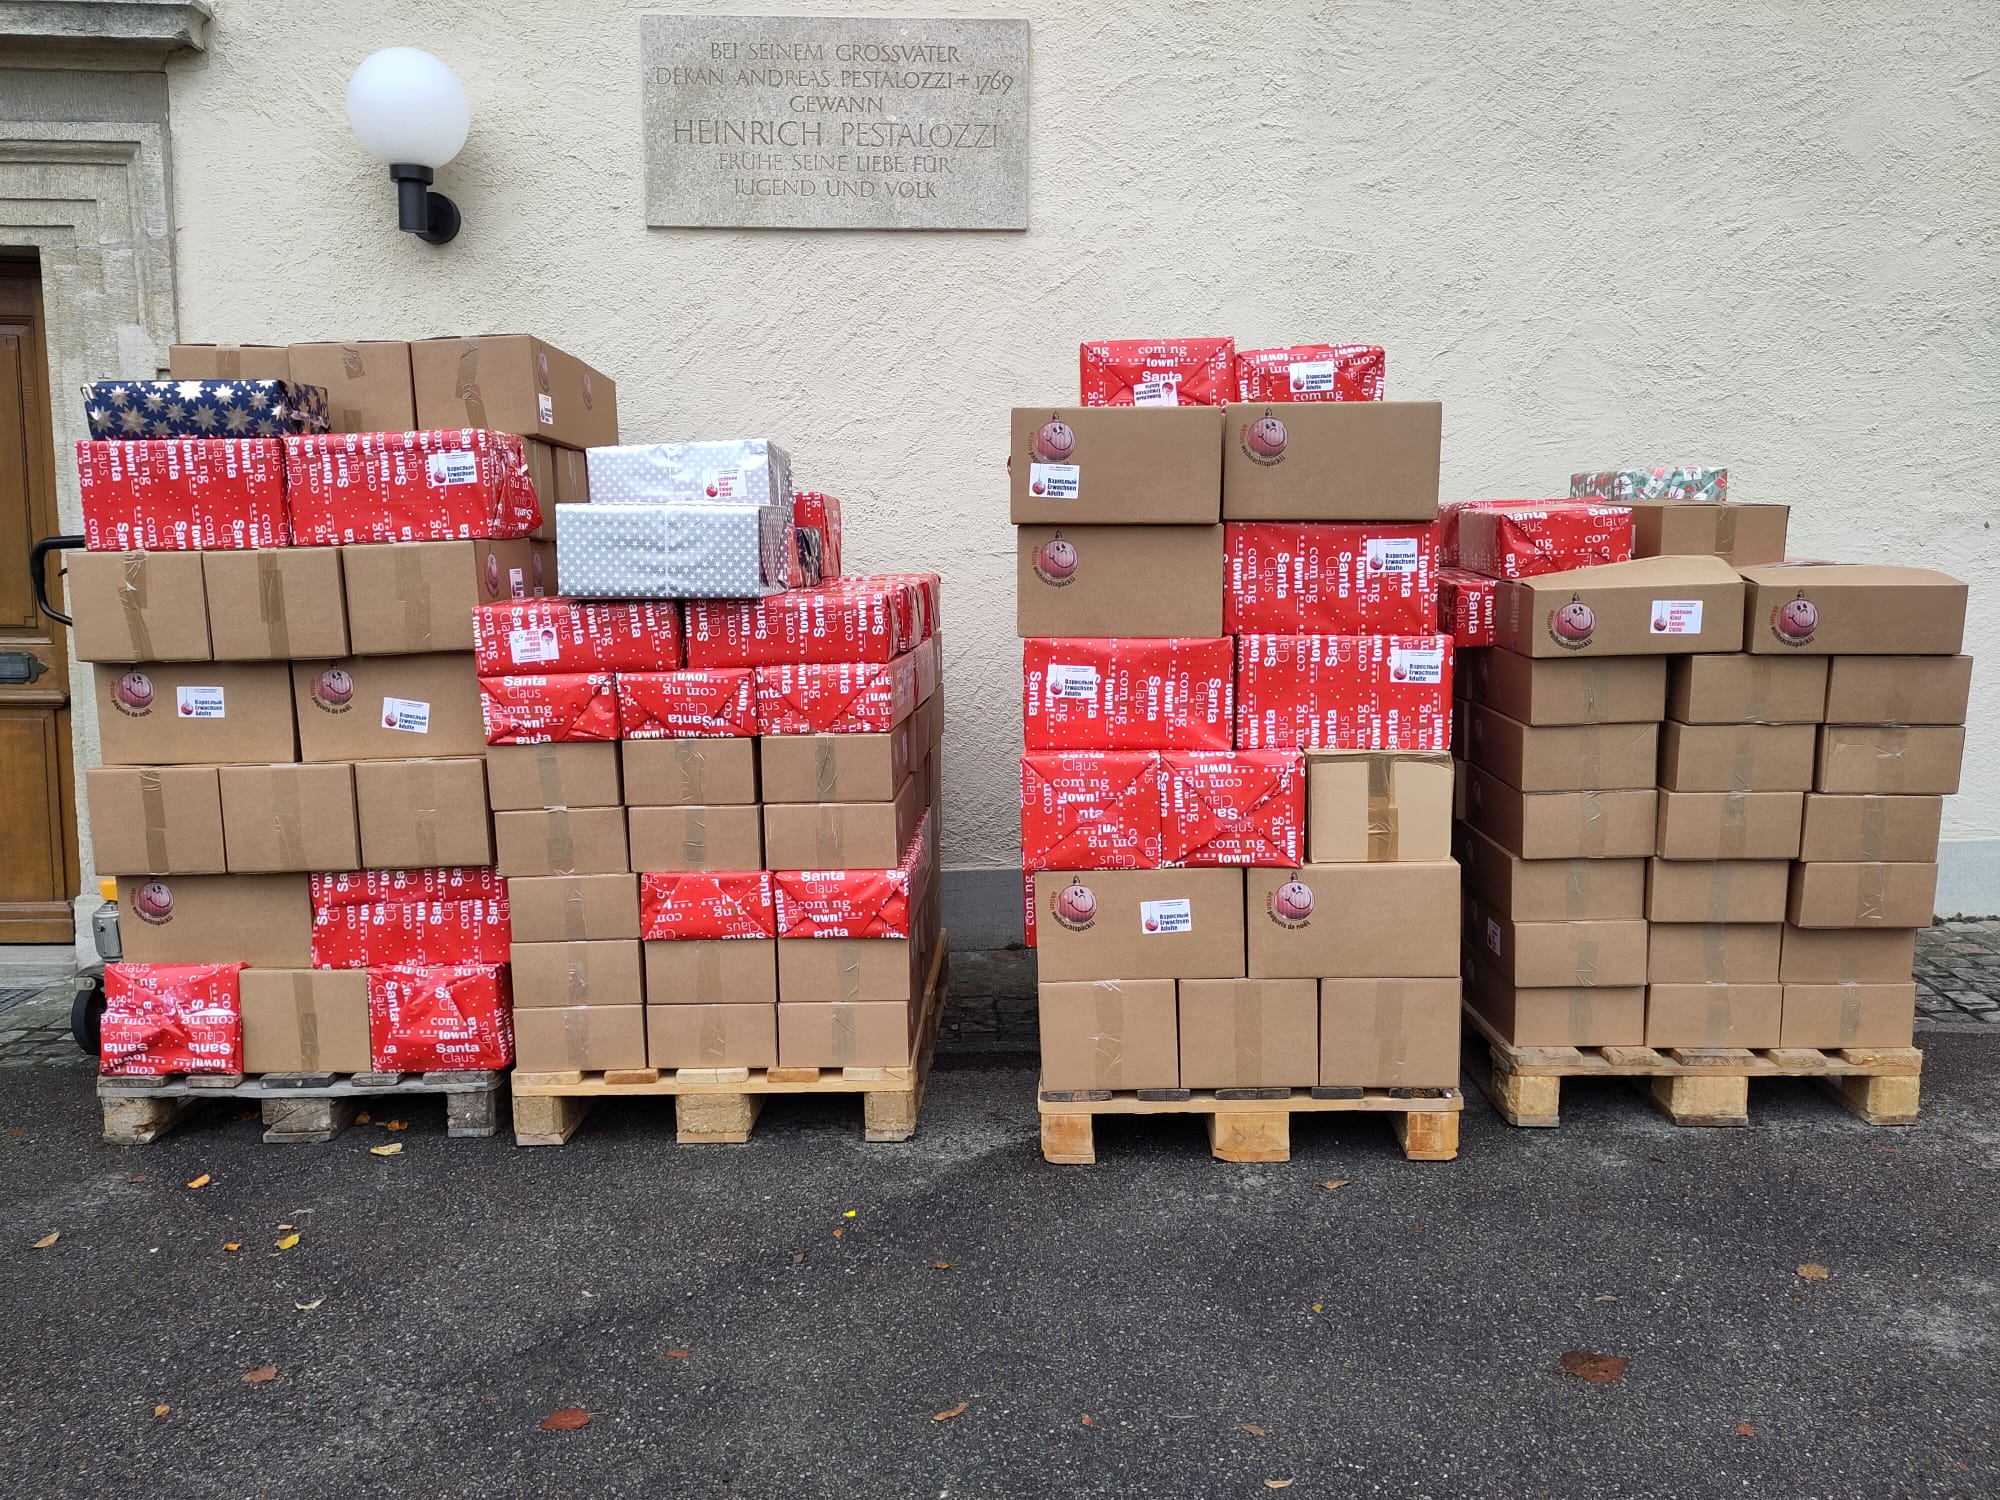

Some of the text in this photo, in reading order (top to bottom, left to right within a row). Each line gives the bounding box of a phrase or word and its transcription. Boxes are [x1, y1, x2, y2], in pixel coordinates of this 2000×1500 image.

[711, 43, 960, 63] BEI SEINEM GROSSVATER
[656, 67, 724, 85] DEKAN
[736, 70, 831, 87] ANDREAS
[842, 71, 952, 89] PESTALOZZI
[977, 70, 1013, 95] 1769
[789, 96, 882, 113] GEWANN
[674, 120, 997, 148] HEINRICH PESTALOZZI
[793, 155, 847, 172] SEINE
[857, 156, 904, 173] LIEBE
[913, 154, 952, 173] FÜR
[734, 179, 937, 198] JUGEND UND VOLK
[1147, 358, 1178, 367] town!
[1256, 353, 1288, 364] town!
[1335, 347, 1367, 357] town!
[1142, 371, 1182, 382] Santa
[110, 440, 122, 481] Santa
[125, 441, 137, 476] town!
[167, 439, 179, 480] Santa
[183, 440, 196, 474] town!
[225, 438, 236, 478] Santa
[241, 439, 254, 473] town!
[1233, 558, 1244, 594] town!
[1264, 557, 1277, 593] Claus
[1277, 552, 1289, 599] Santa
[1294, 557, 1304, 594] town!
[1326, 556, 1339, 592] Claus
[1339, 552, 1351, 598] Santa
[1356, 556, 1366, 593] town!
[1418, 555, 1429, 592] town!
[557, 606, 570, 640] Claus
[570, 603, 584, 644] Santa
[586, 604, 600, 638] town!
[697, 599, 708, 641] Santa
[709, 602, 720, 637] Claus
[741, 601, 750, 634] town!
[756, 598, 766, 639] Santa
[766, 601, 778, 635] Claus
[799, 596, 808, 634] town!
[814, 595, 825, 637] Santa
[826, 598, 837, 633] Claus
[858, 596, 867, 632] town!
[873, 593, 884, 635] Santa
[1457, 595, 1468, 628] Claus
[1469, 592, 1480, 634] Santa
[1484, 596, 1494, 629] town!
[472, 617, 485, 651] town!
[503, 676, 546, 686] Santa
[508, 688, 541, 698] Claus
[672, 672, 708, 683] town!
[1028, 671, 1041, 716] Santa
[673, 701, 708, 715] Claus
[1104, 679, 1114, 714] town!
[1135, 679, 1148, 715] Claus
[1148, 676, 1160, 721] Santa
[1164, 681, 1175, 717] town!
[1195, 682, 1208, 717] Claus
[1207, 678, 1221, 723] Santa
[1224, 683, 1233, 719] town!
[668, 714, 711, 724] Santa
[1248, 713, 1258, 749] town!
[1309, 713, 1320, 749] town!
[1337, 715, 1349, 749] Claus
[1370, 713, 1381, 749] town!
[1399, 715, 1411, 749] Claus
[1432, 713, 1443, 749] town!
[1062, 759, 1098, 771] Claus
[1195, 763, 1231, 774] town!
[1024, 770, 1036, 805] Claus
[1065, 790, 1099, 803] town!
[1160, 771, 1169, 817] Santa
[1174, 776, 1186, 813] town!
[1100, 854, 1136, 866] Claus
[1218, 853, 1255, 863] town!
[800, 871, 845, 881] Santa
[806, 881, 839, 894] Claus
[726, 921, 762, 933] Claus
[776, 889, 785, 933] Santa
[1052, 911, 1095, 932] weihnachtspäckli
[116, 964, 149, 973] Claus
[376, 984, 386, 1016] Claus
[386, 981, 399, 1022] Santa
[104, 1043, 148, 1052] Santa
[111, 1031, 142, 1043] Claus
[188, 1042, 230, 1054] Santa
[192, 1031, 226, 1043] Claus
[436, 1043, 480, 1053] Santa
[439, 1029, 473, 1039] town!
[110, 1054, 146, 1067] town!
[192, 1058, 226, 1068] town!
[442, 1053, 475, 1063] Claus
